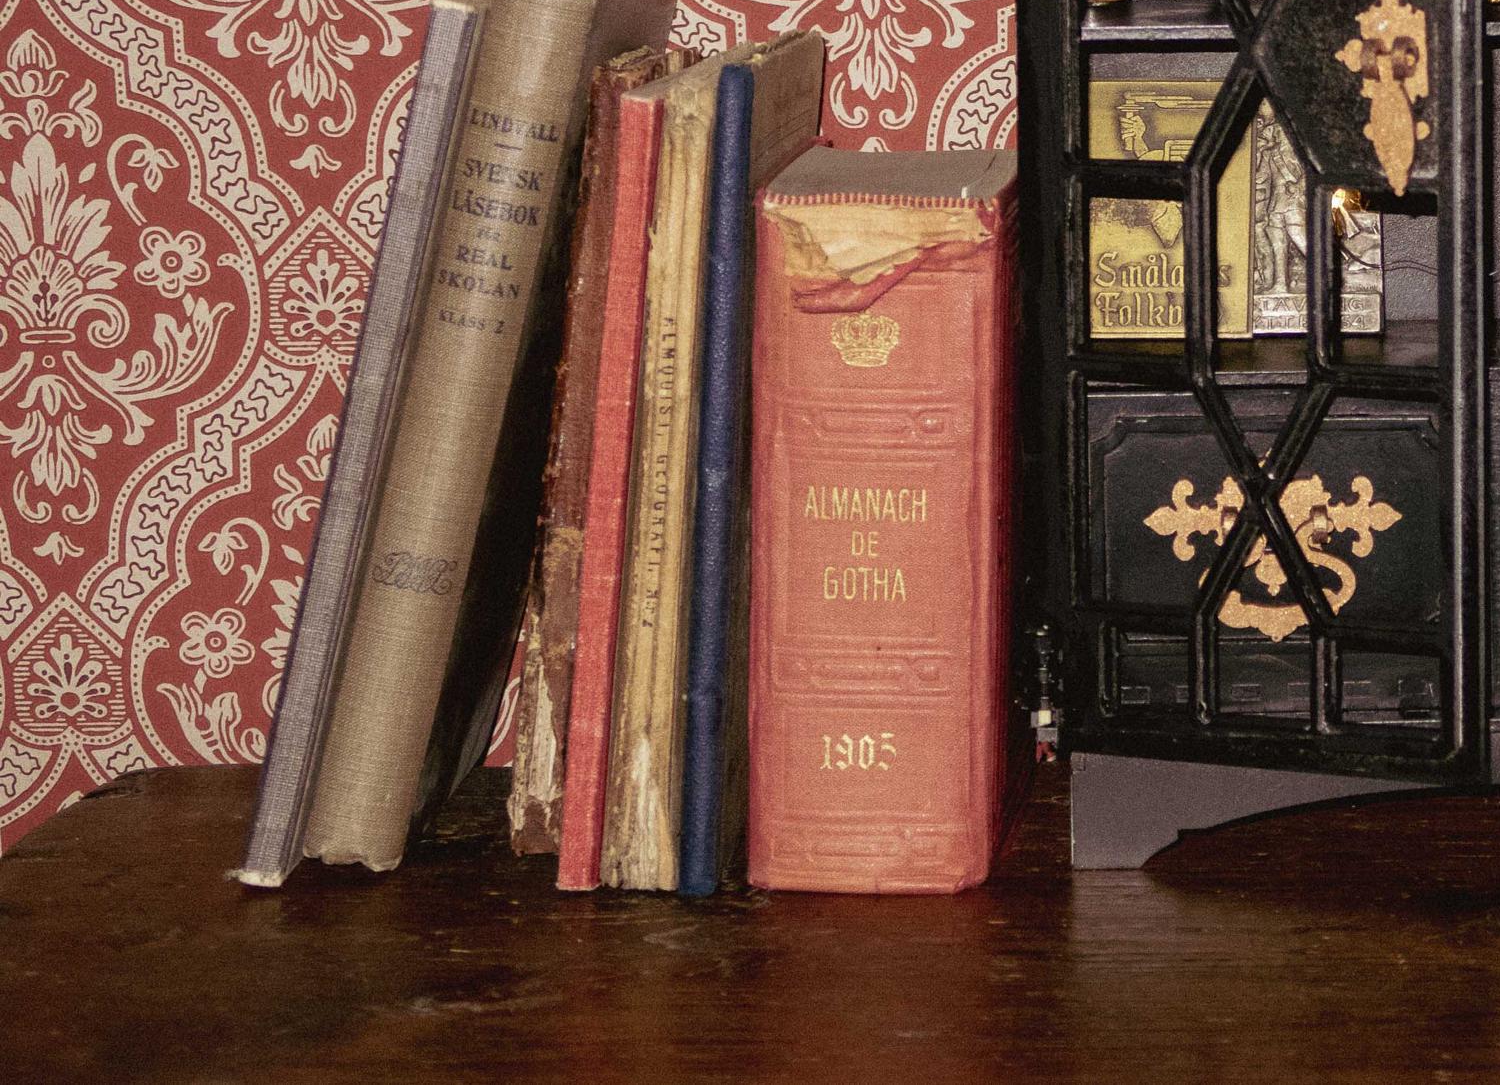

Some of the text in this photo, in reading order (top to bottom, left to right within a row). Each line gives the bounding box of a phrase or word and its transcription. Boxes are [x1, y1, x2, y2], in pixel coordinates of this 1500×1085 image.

[455, 244, 513, 271] REAL
[1094, 251, 1232, 287] Smålas
[438, 268, 520, 299] SKOLAN
[805, 485, 928, 522] ALMANACH
[851, 530, 879, 558] DE
[823, 566, 907, 602] GOTHA
[819, 732, 898, 772] 1905
